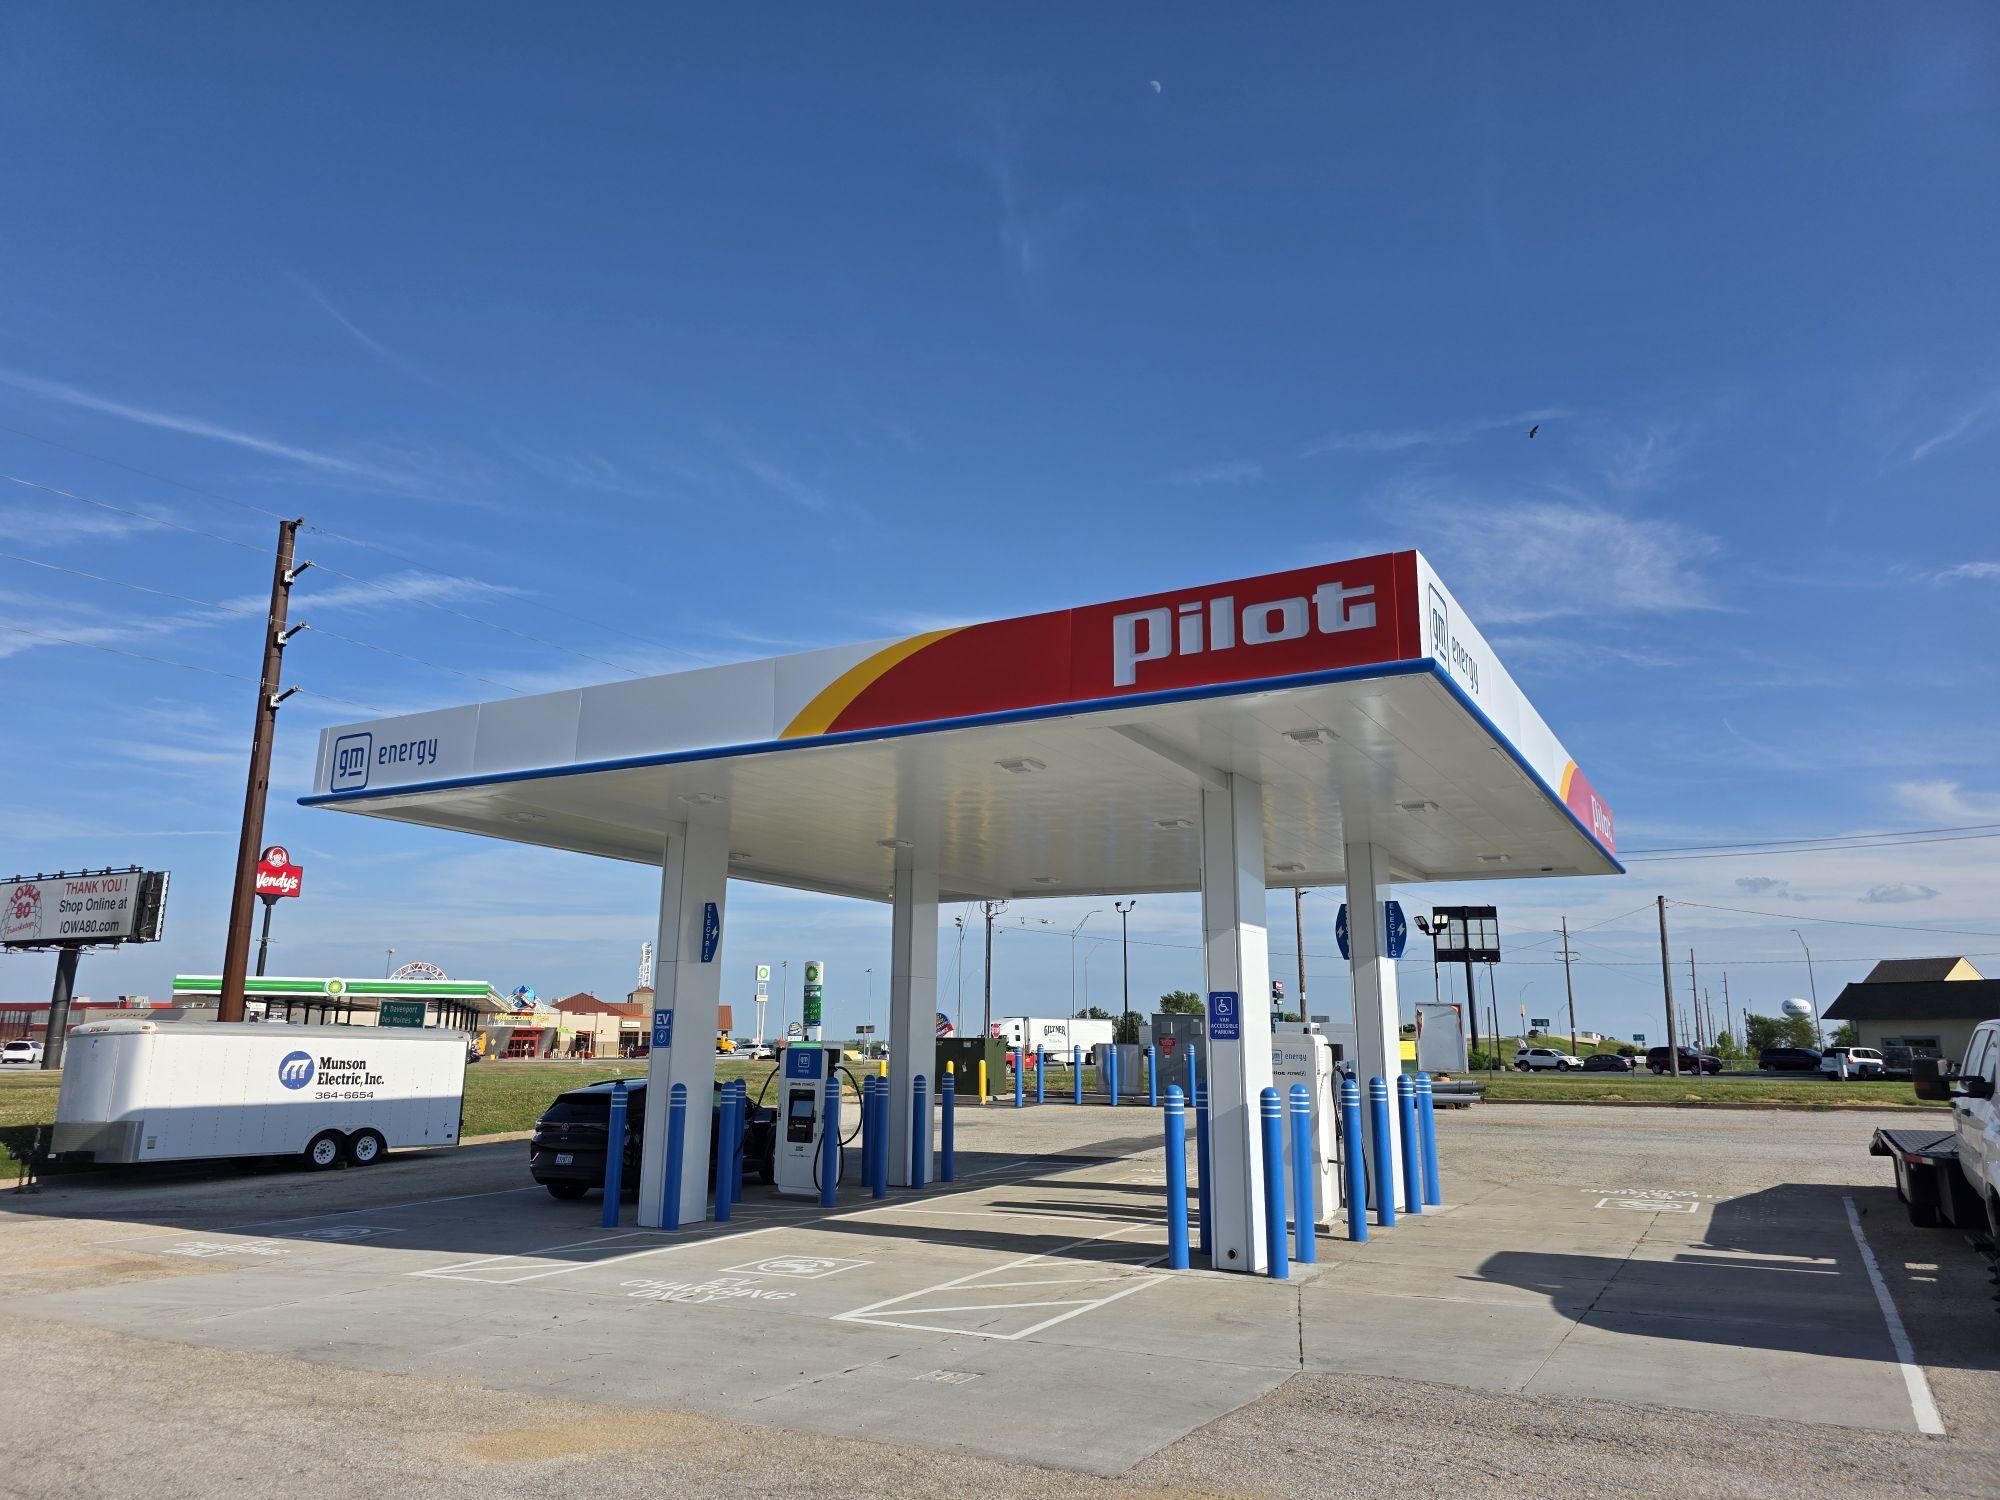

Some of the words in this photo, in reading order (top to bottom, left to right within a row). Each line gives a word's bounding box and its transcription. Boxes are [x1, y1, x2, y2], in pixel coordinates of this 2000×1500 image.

[1432, 608, 1446, 651] gm
[1451, 636, 1479, 694] energy
[339, 747, 365, 778] gm
[378, 738, 438, 766] energy
[65, 880, 98, 895] THANK
[101, 879, 122, 893] YOU
[15, 902, 31, 919] 80
[59, 900, 83, 915] Shop
[86, 898, 115, 912] Online
[117, 897, 128, 909] at
[59, 919, 119, 934] IOWA80.com
[703, 904, 713, 961] ELECTRIC
[1389, 903, 1397, 956] ELECTRIC
[389, 1005, 418, 1014] Davenport
[393, 1016, 412, 1024] Moines
[655, 1013, 670, 1025] EV
[1043, 1025, 1067, 1037] GILTNER
[318, 1056, 367, 1070] Munson
[1284, 1053, 1307, 1062] energy
[317, 1072, 363, 1087] Electric,
[364, 1072, 385, 1085] Inc.
[314, 1091, 374, 1100] 364-6654
[619, 1279, 797, 1300] CHARGING
[626, 1289, 731, 1304] ONLY
